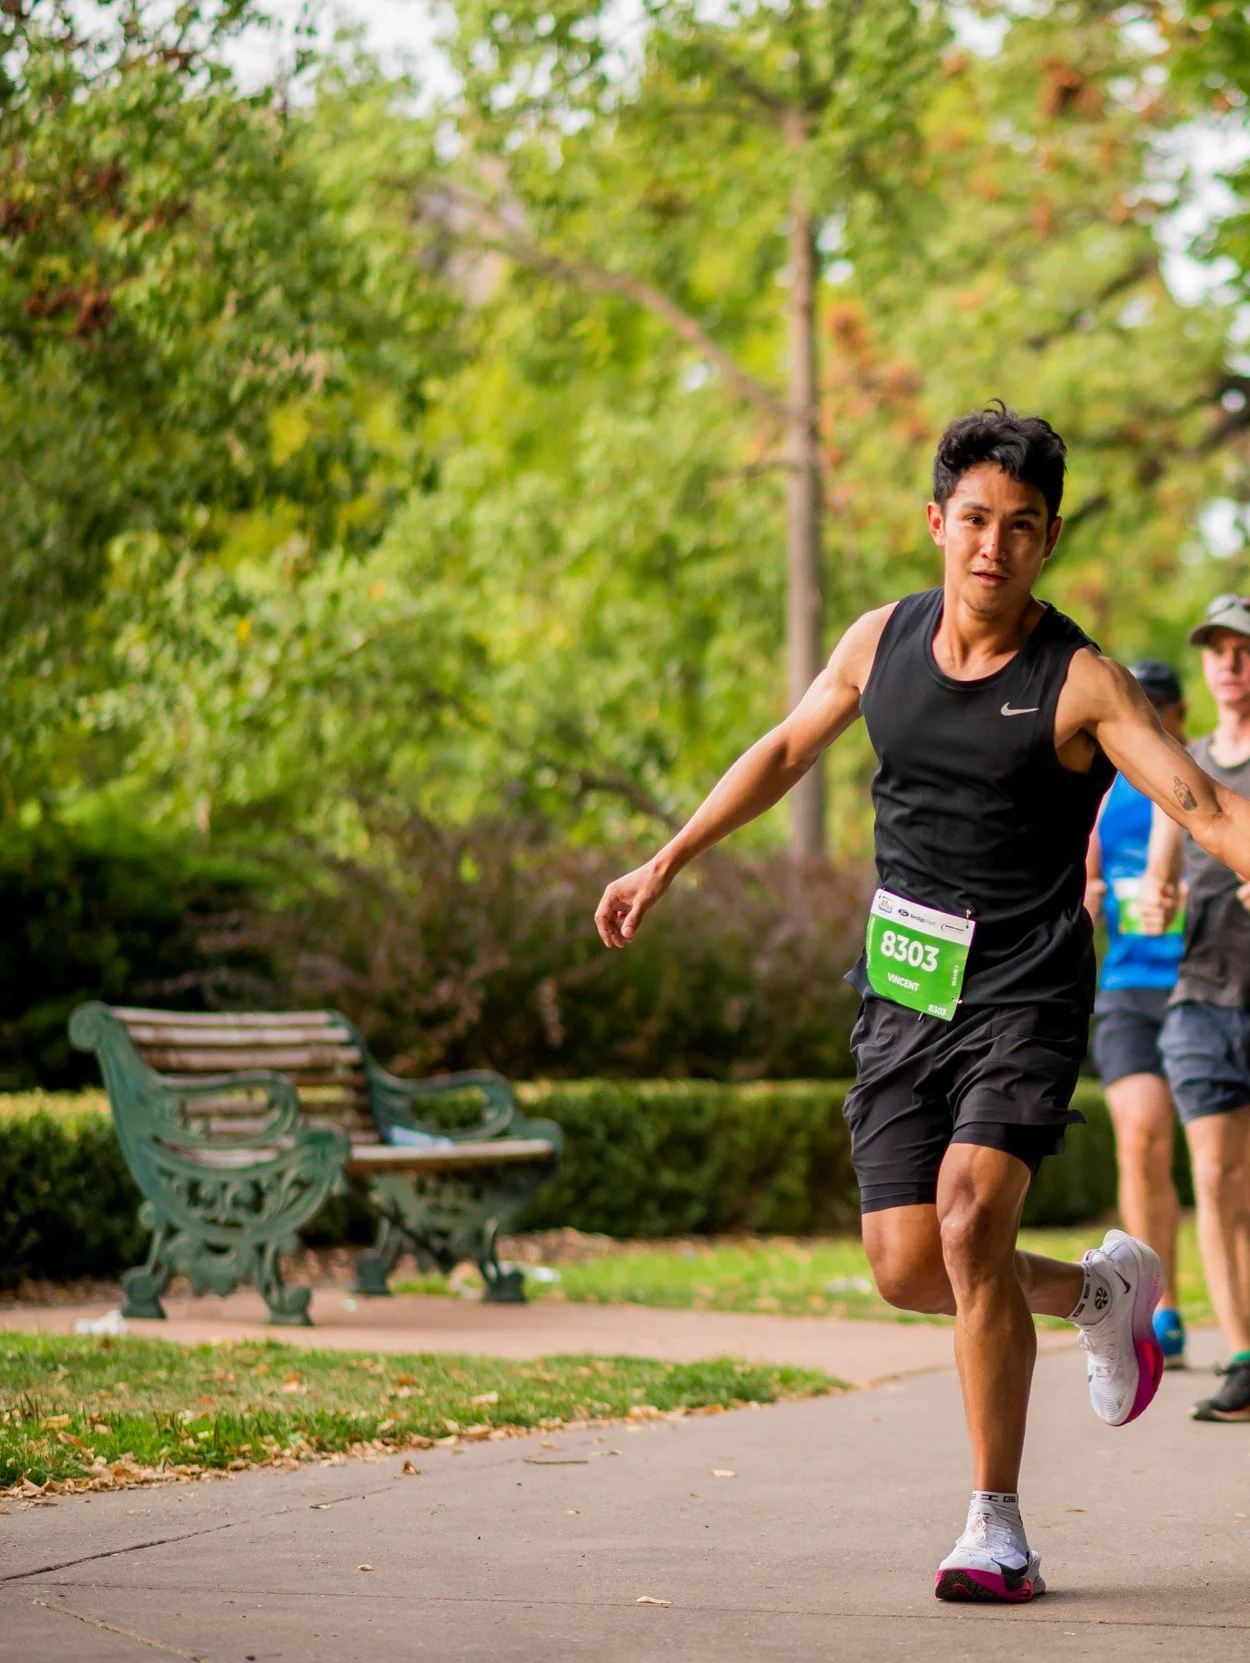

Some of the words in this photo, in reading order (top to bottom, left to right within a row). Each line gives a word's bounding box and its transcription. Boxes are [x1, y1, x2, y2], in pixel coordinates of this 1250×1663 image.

[881, 930, 939, 973] 8303
[887, 972, 920, 992] VINCENT
[927, 1004, 947, 1016] 8303
